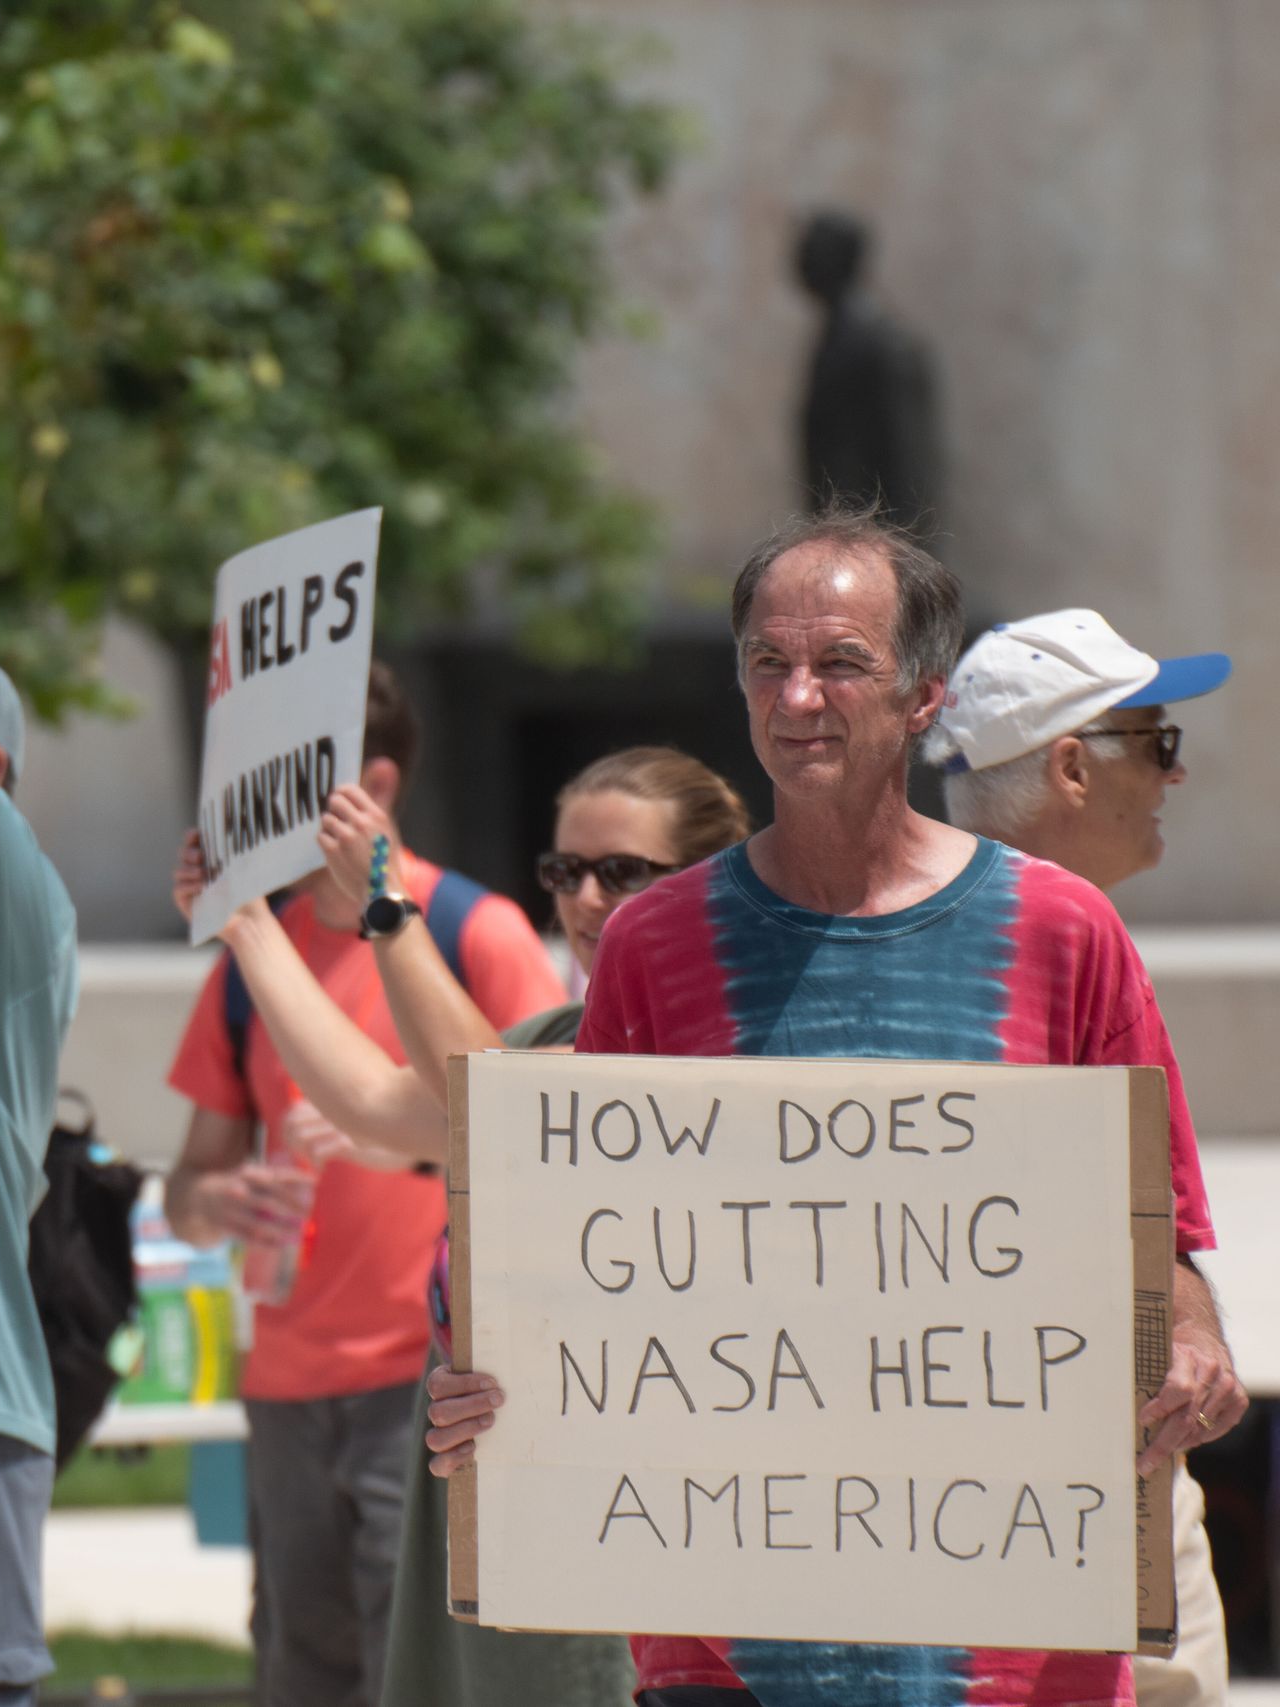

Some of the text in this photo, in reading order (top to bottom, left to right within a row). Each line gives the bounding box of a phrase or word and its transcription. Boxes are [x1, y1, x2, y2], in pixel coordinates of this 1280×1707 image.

[240, 560, 365, 682] HELPS
[200, 737, 336, 885] LL MANKIND
[539, 1090, 977, 1166] HOW DOES
[579, 1194, 1024, 1295] GUTTING
[559, 1325, 1089, 1416] NASA HELP
[598, 1473, 1106, 1569] AMERICA?
